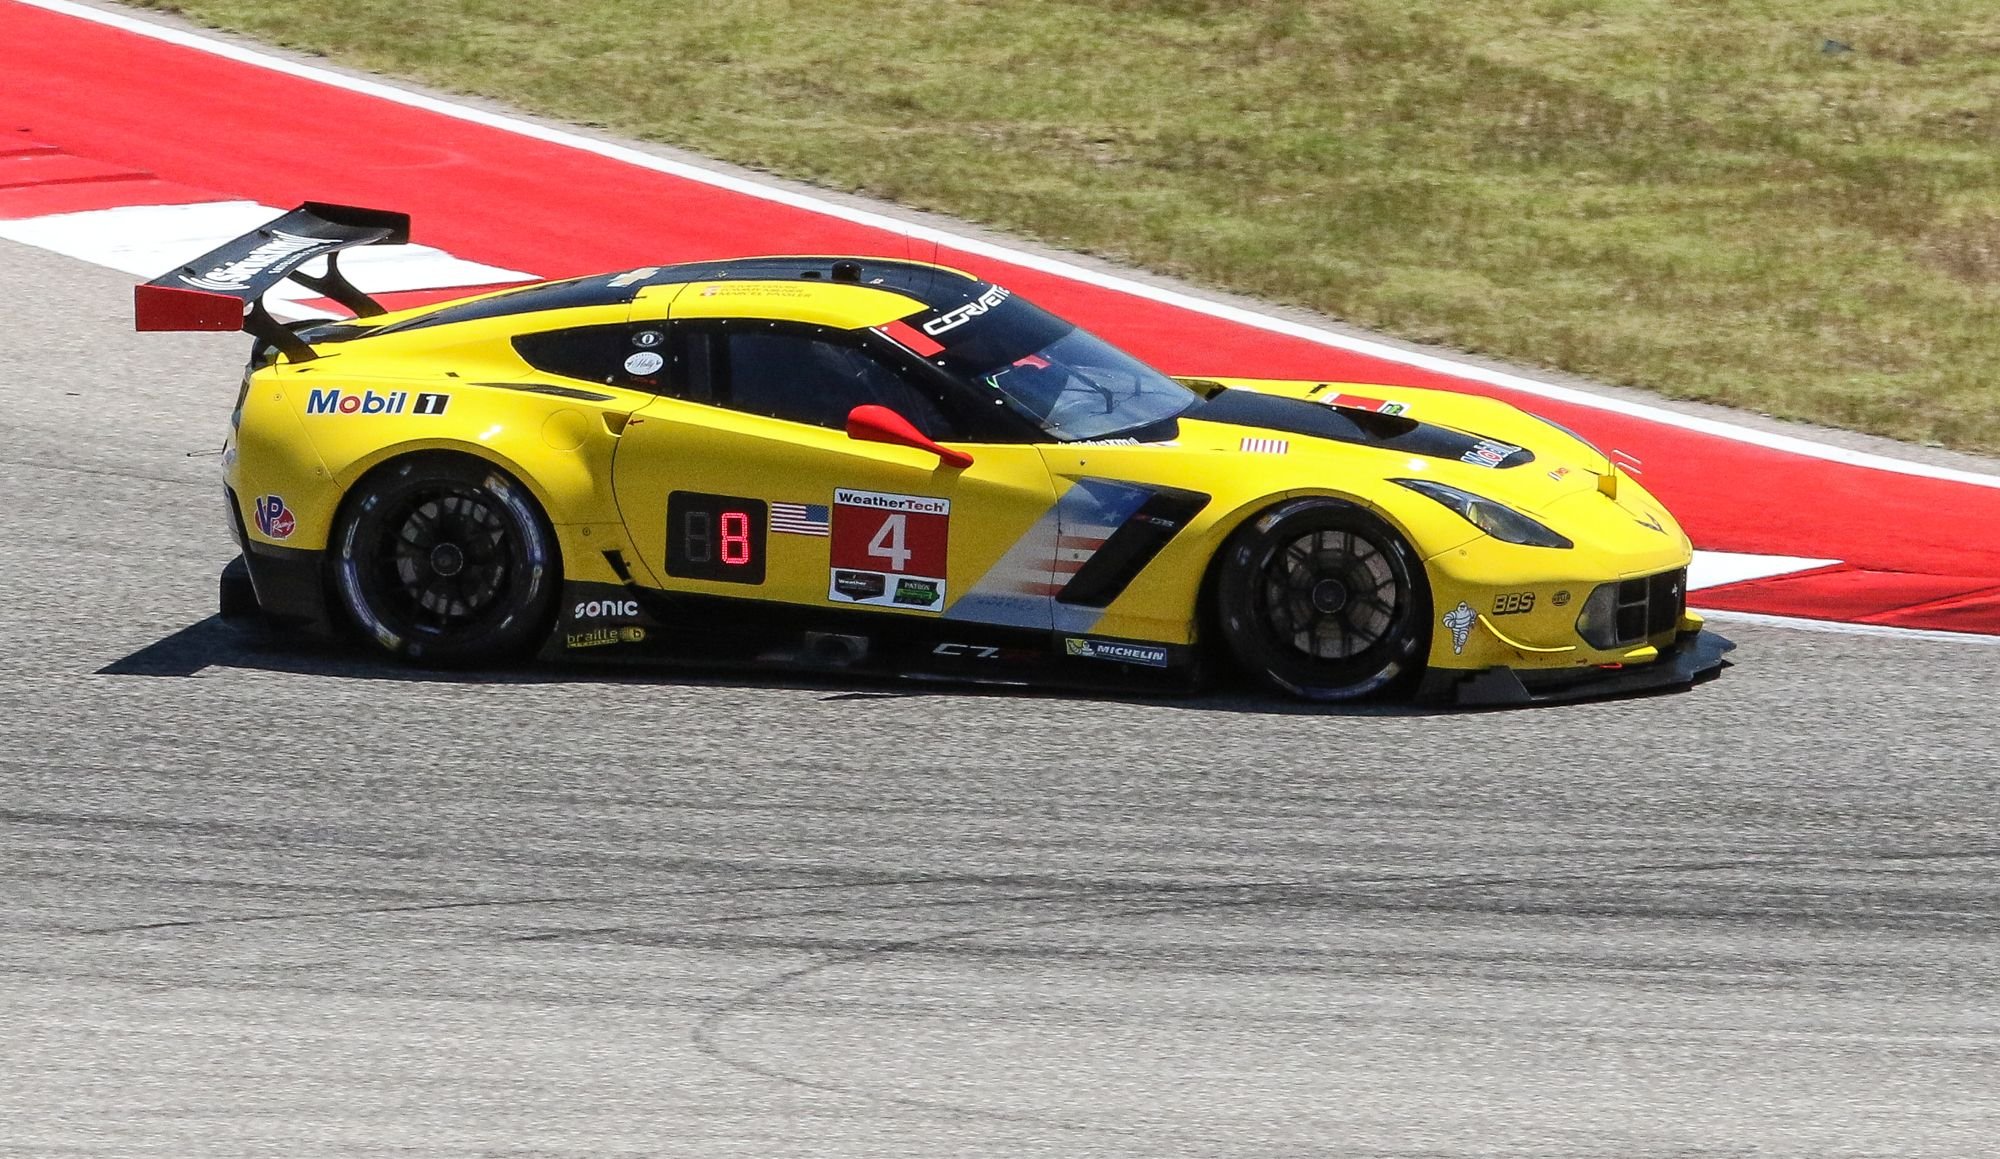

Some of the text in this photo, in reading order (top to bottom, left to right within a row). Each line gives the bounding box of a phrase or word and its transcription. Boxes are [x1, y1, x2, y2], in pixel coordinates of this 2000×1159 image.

[306, 389, 408, 414] Mobil
[838, 492, 945, 513] WeatherTech
[255, 495, 285, 537] VP
[722, 512, 749, 565] 8
[867, 513, 912, 571] 4
[1492, 592, 1536, 615] BBS
[567, 628, 619, 643] braille
[1096, 645, 1165, 661] MICHELIN
